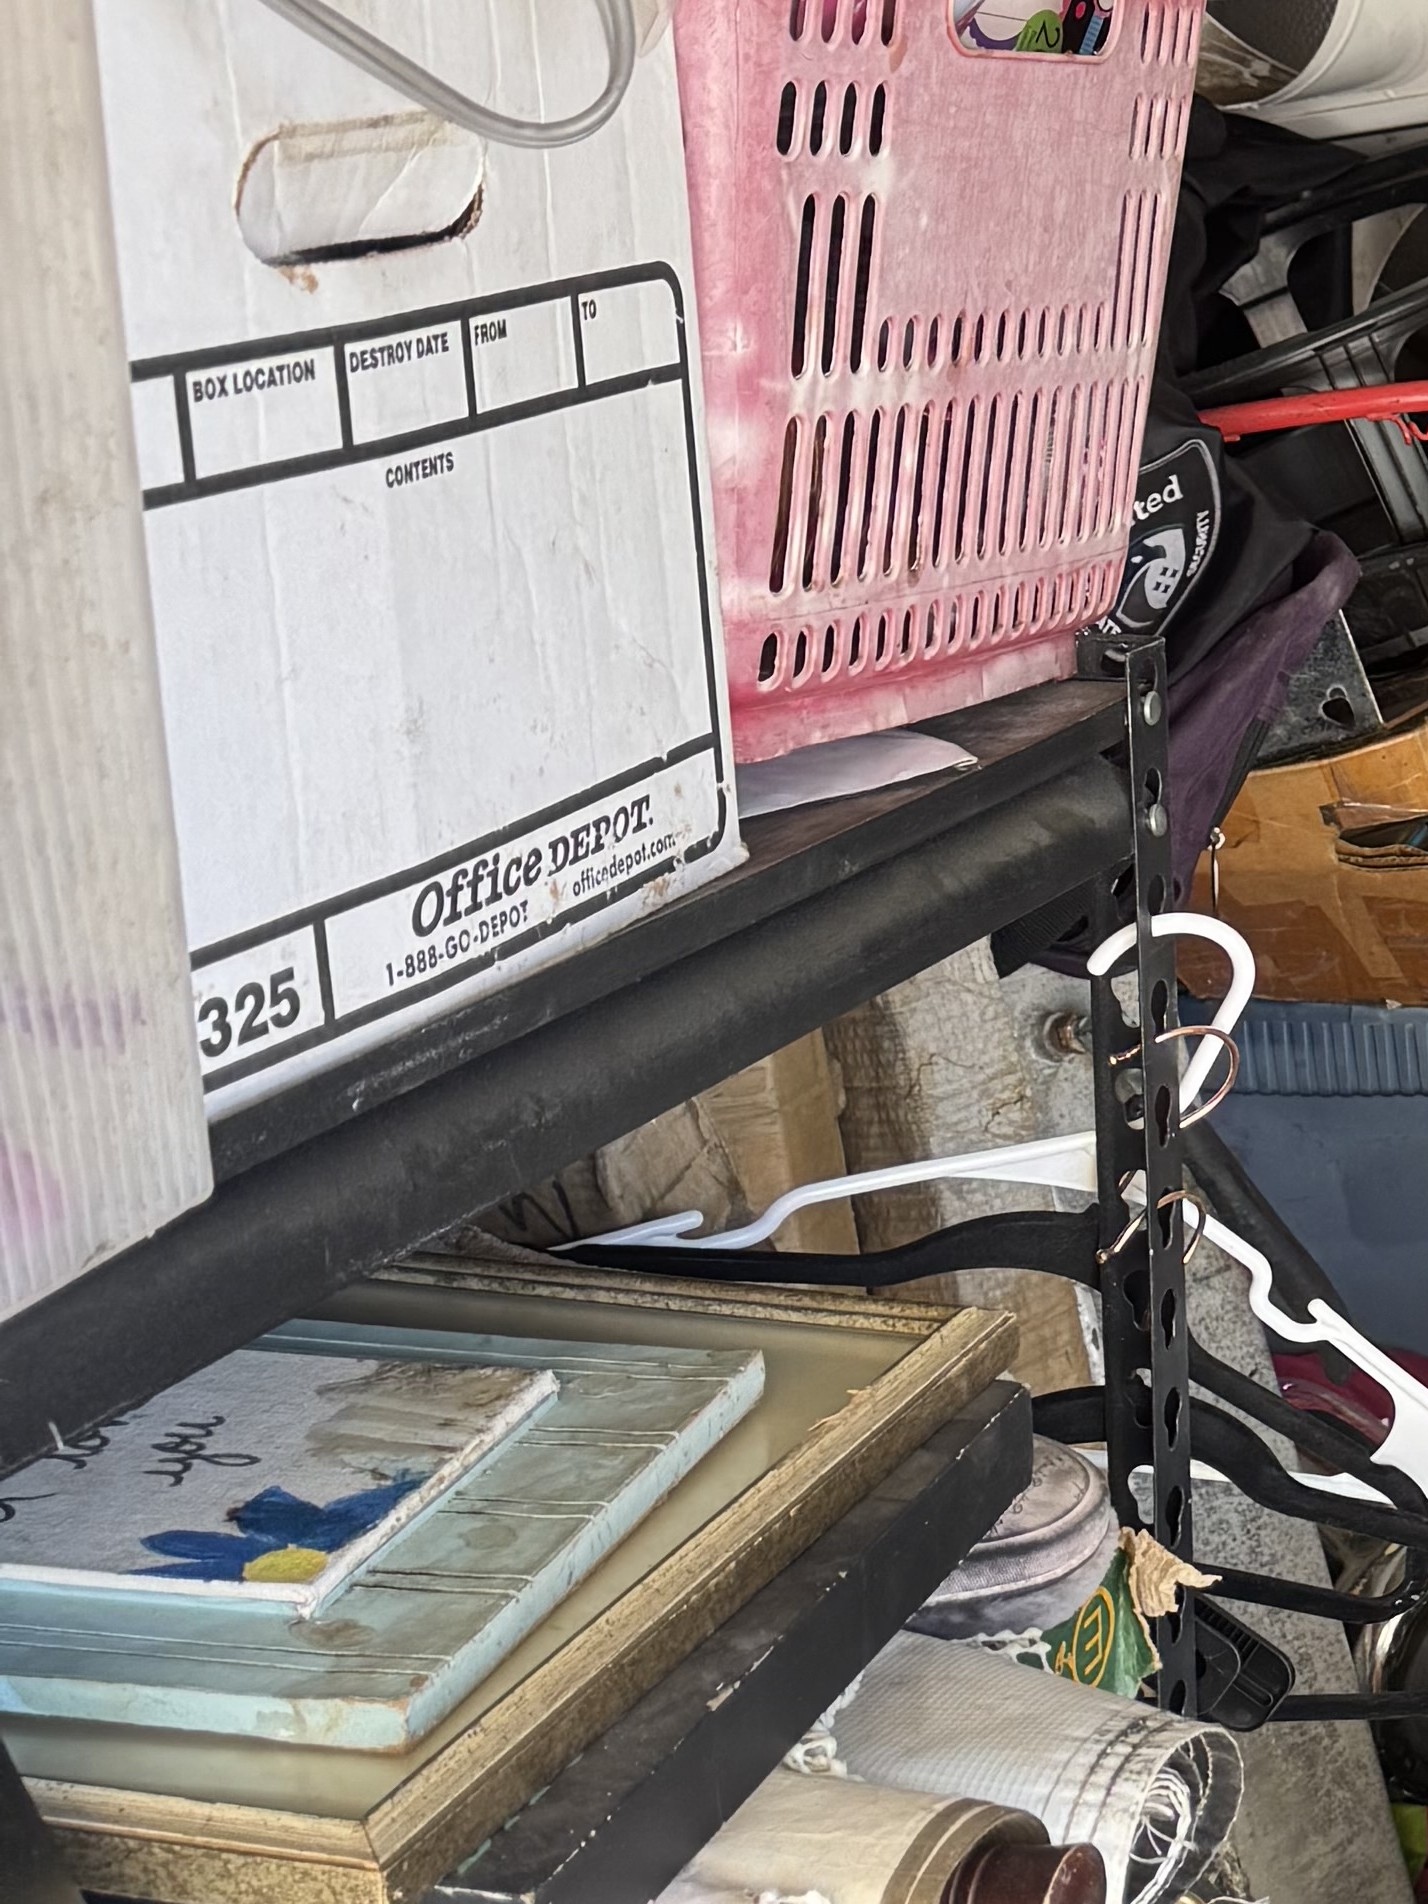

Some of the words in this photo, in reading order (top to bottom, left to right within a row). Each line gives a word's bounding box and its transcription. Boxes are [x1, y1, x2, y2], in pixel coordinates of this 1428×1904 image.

[580, 298, 598, 321] TO
[349, 339, 414, 373] DESTROY
[415, 332, 450, 360] DATE
[473, 319, 507, 346] FROM
[193, 371, 229, 403] BOX
[233, 358, 316, 396] LOCATION
[385, 451, 455, 489] CONTENTS
[571, 831, 678, 898] officedepot.com
[411, 846, 542, 938] Office
[197, 966, 301, 1058] 325
